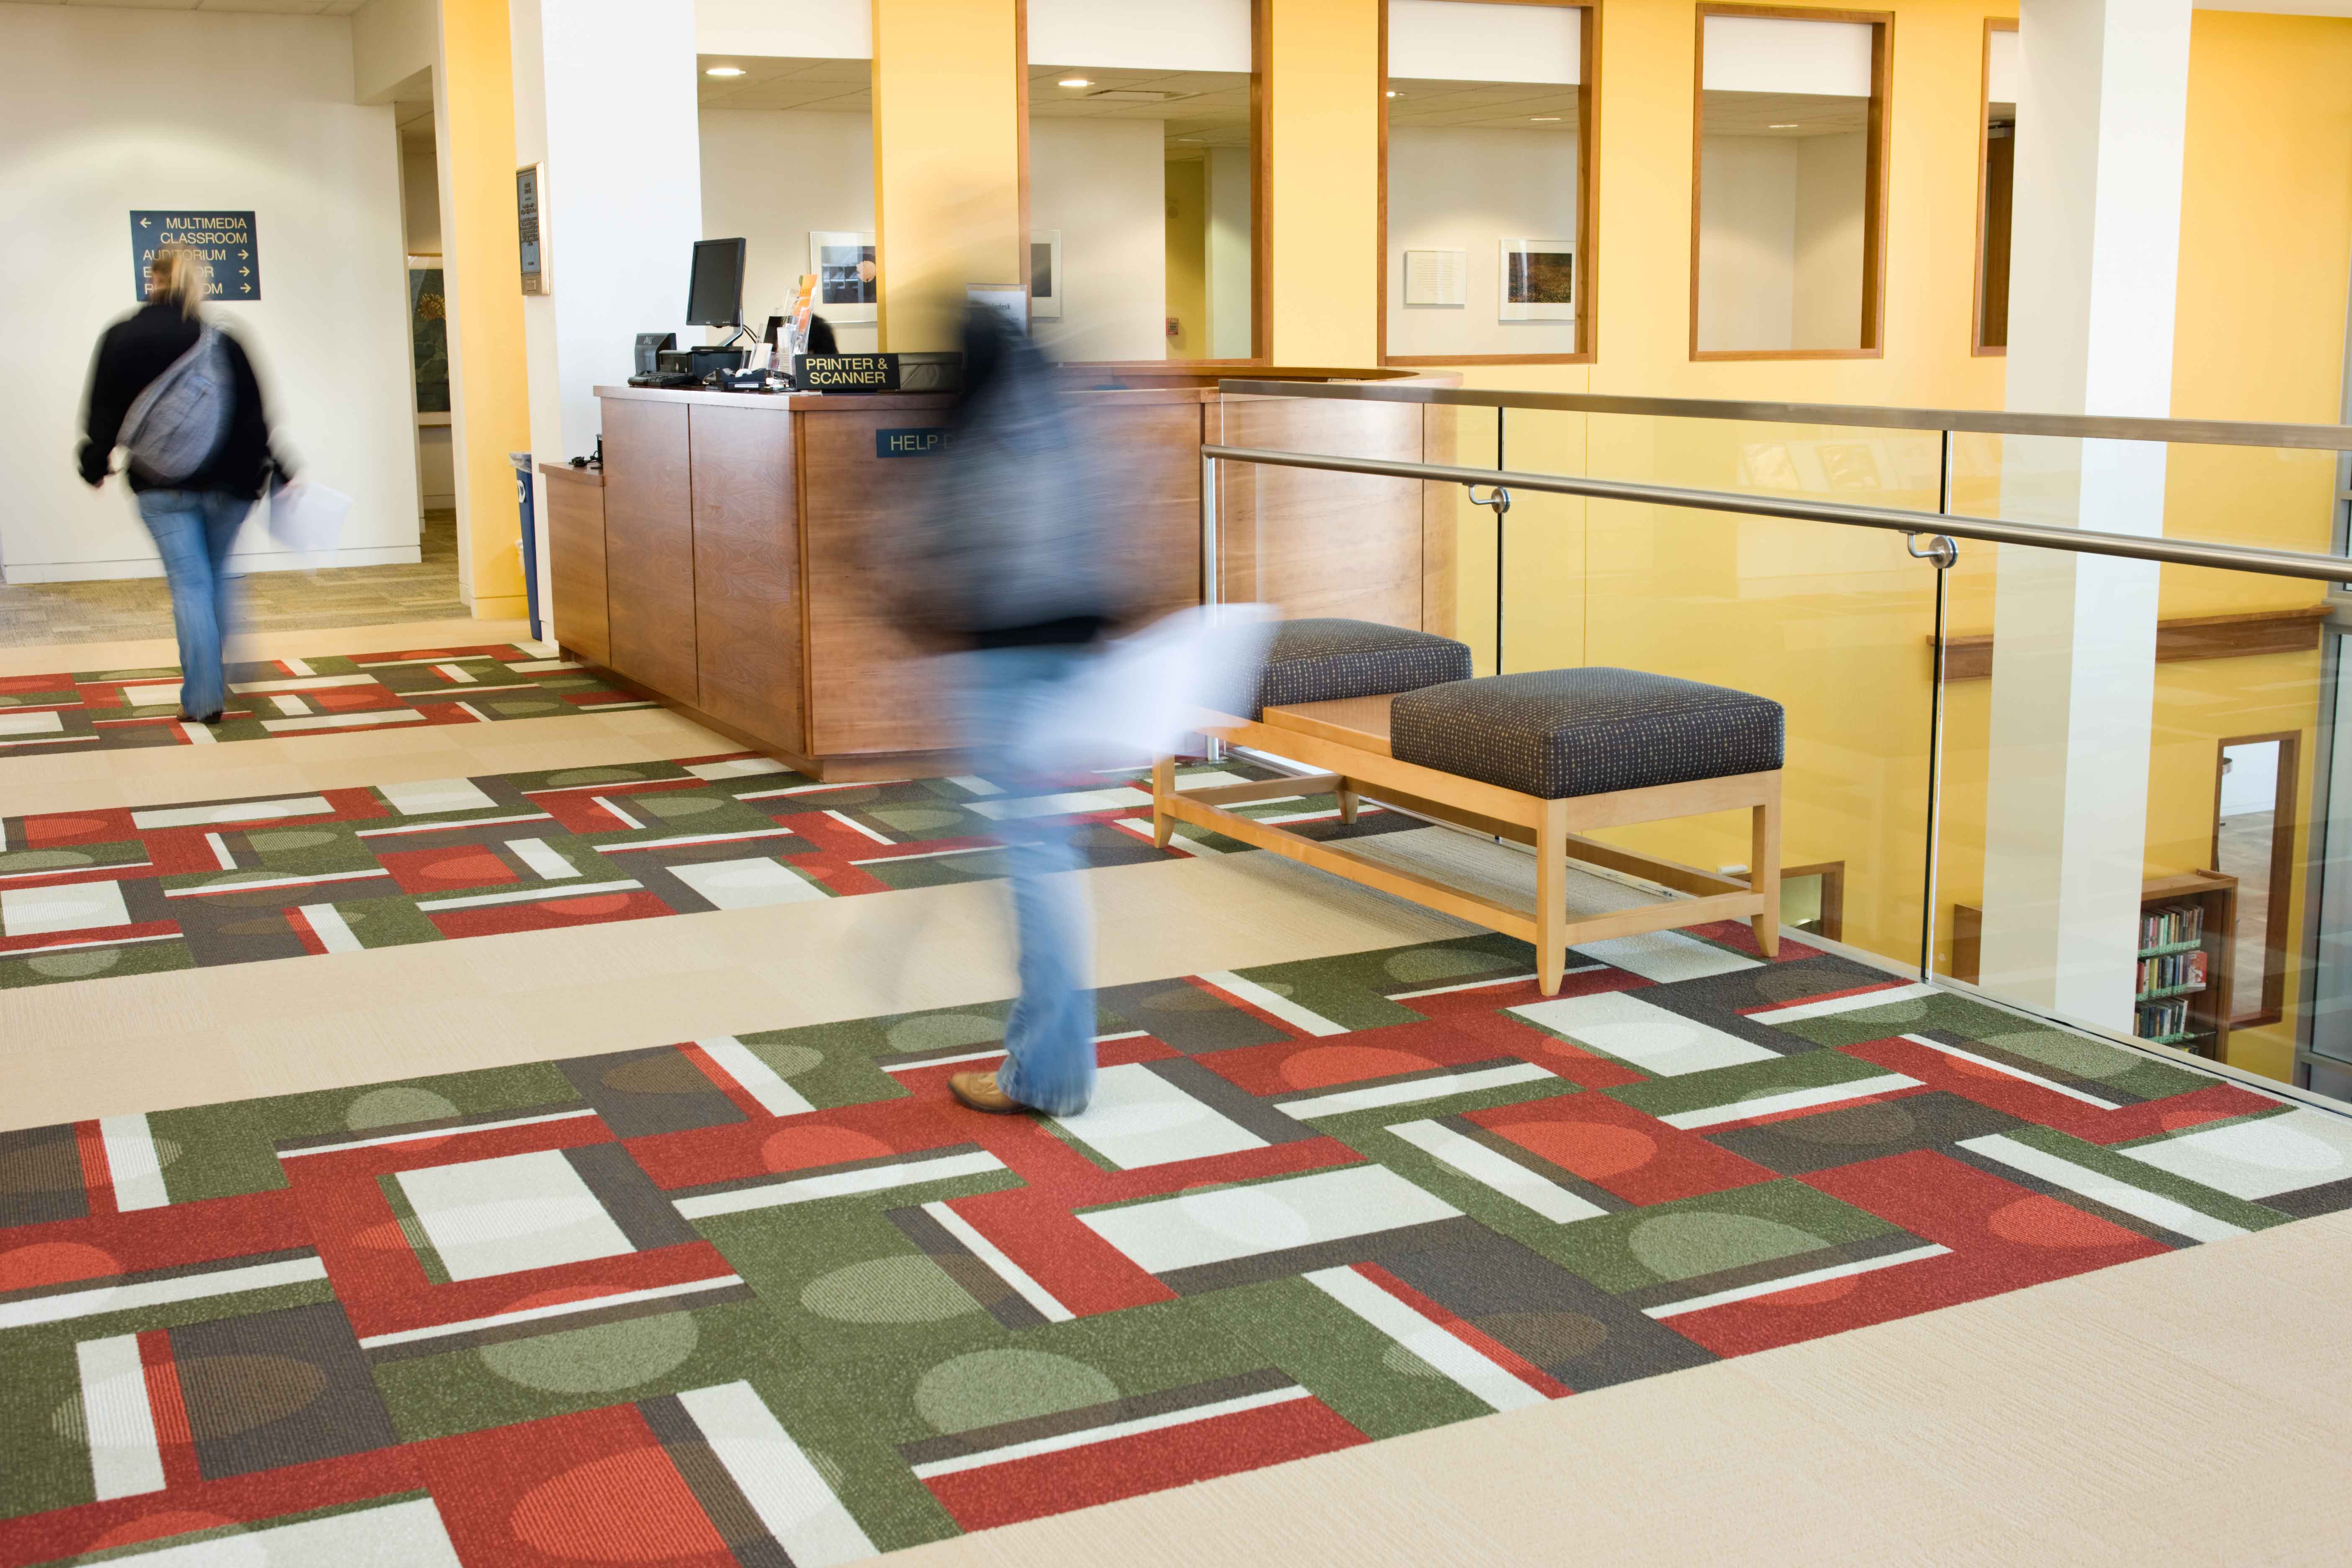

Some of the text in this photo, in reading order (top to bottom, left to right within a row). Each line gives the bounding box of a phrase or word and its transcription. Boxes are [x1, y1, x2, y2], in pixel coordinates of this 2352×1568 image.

[166, 218, 247, 229] MULTIMEDIA
[160, 233, 247, 244] CLASSROOM
[806, 358, 888, 370] PRINTER &
[810, 371, 886, 384] SCANNER
[891, 435, 938, 451] HELP
